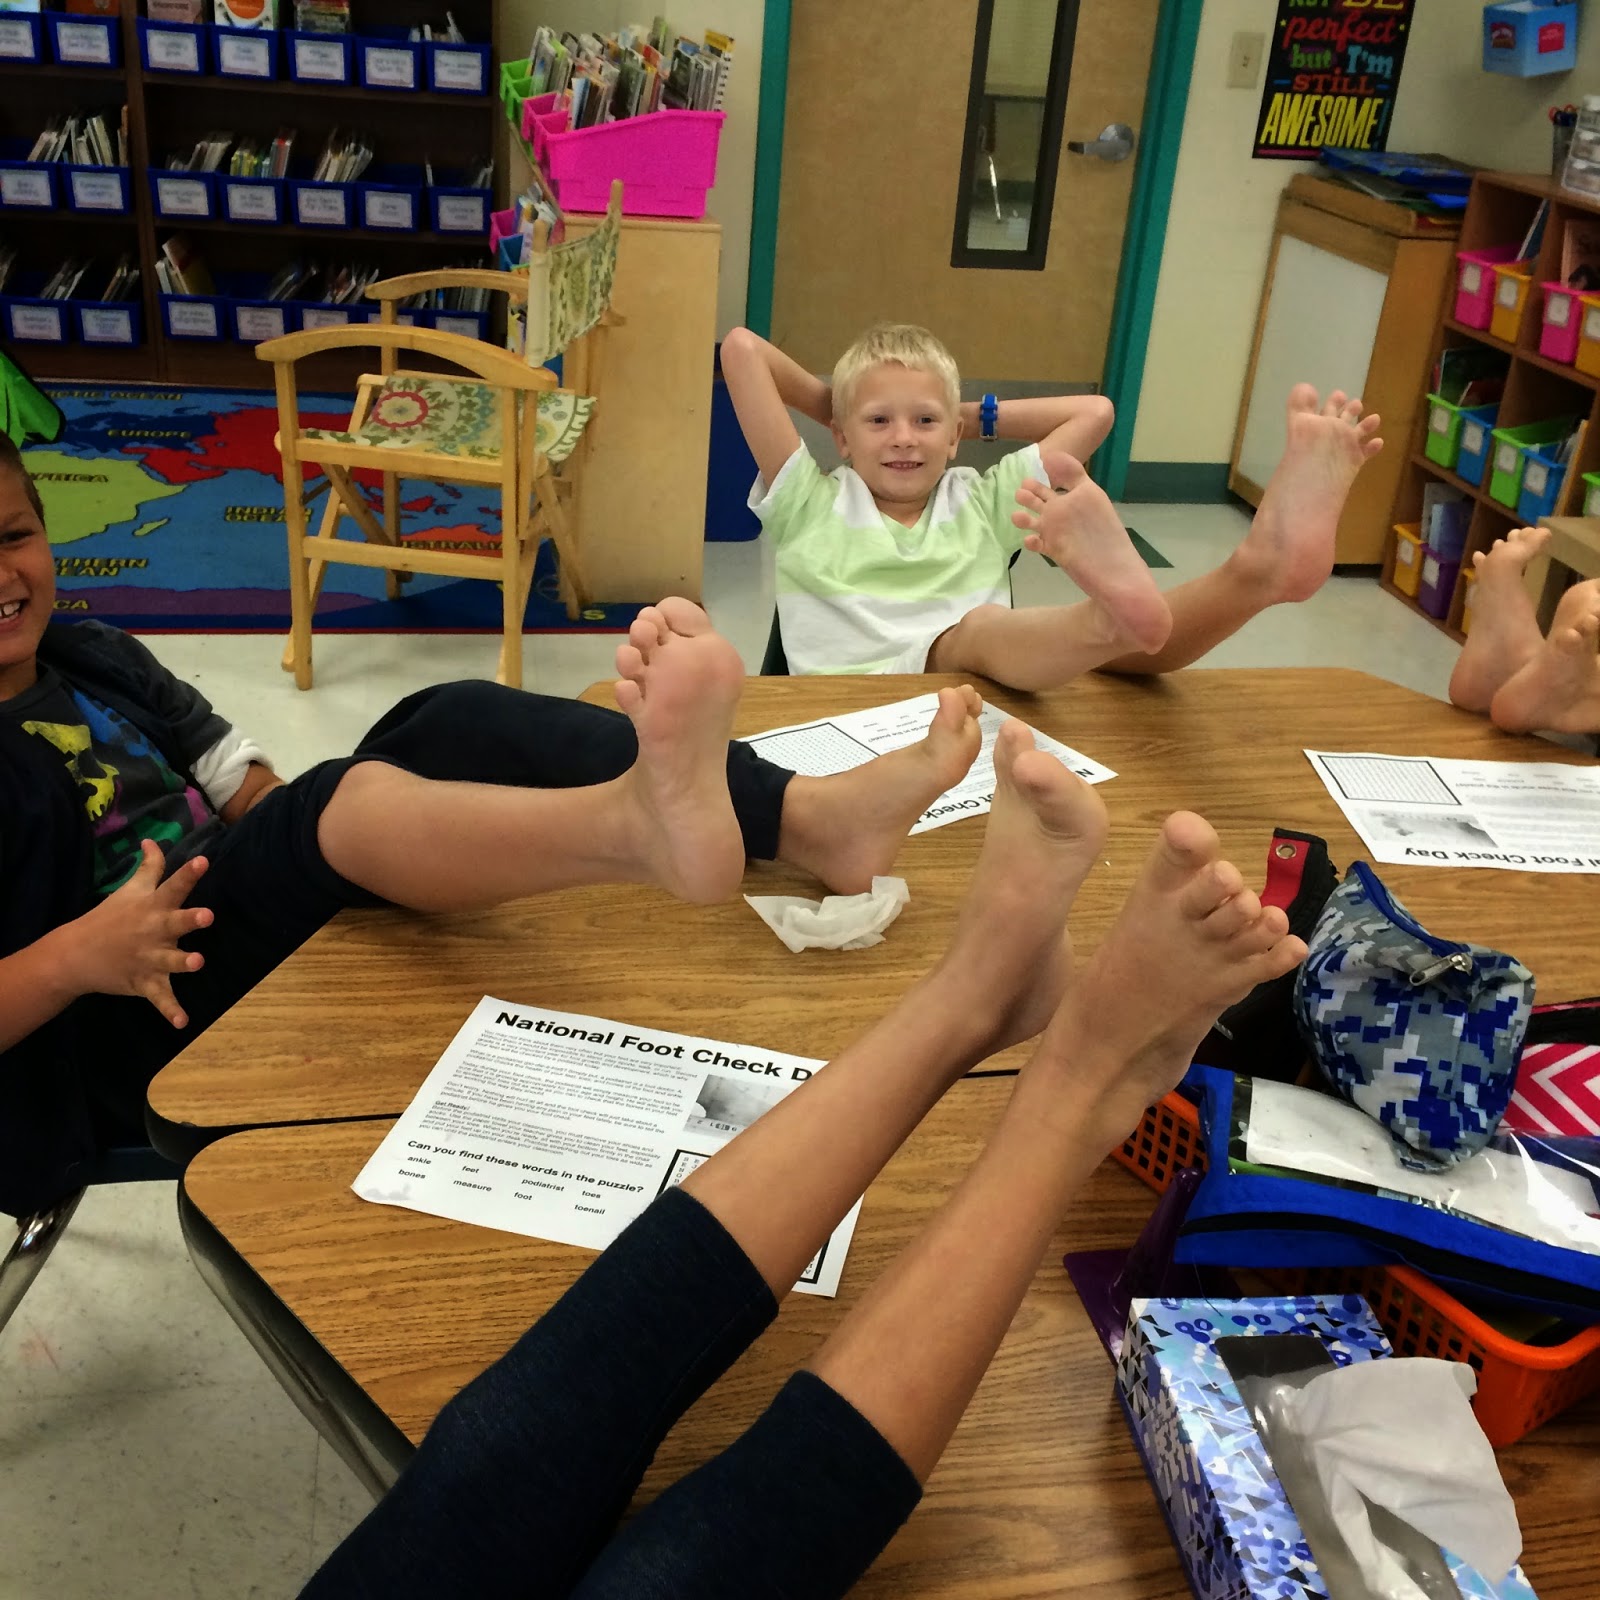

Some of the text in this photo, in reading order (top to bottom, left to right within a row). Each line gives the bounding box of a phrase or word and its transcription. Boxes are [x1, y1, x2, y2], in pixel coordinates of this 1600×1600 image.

[1282, 10, 1397, 53] perfect
[1290, 43, 1394, 79] but I'm
[1259, 92, 1391, 149] AWESOME!
[107, 429, 192, 439] EUROPE
[923, 799, 981, 819] Check
[1404, 847, 1450, 860] Day
[1453, 851, 1527, 864] Check
[1530, 855, 1586, 867] Foot
[494, 1011, 614, 1045] National
[619, 1034, 685, 1059] Foot
[692, 1049, 783, 1077] Check
[407, 1155, 432, 1165] ankle
[407, 1139, 645, 1194] Can you find these words in the puzzle?
[398, 1168, 426, 1180] bones
[461, 1165, 480, 1175] feet
[452, 1180, 492, 1192] measure
[521, 1178, 565, 1192] podiatrist
[513, 1191, 532, 1201] foot
[581, 1190, 601, 1199] toes
[574, 1203, 606, 1216] toenail
